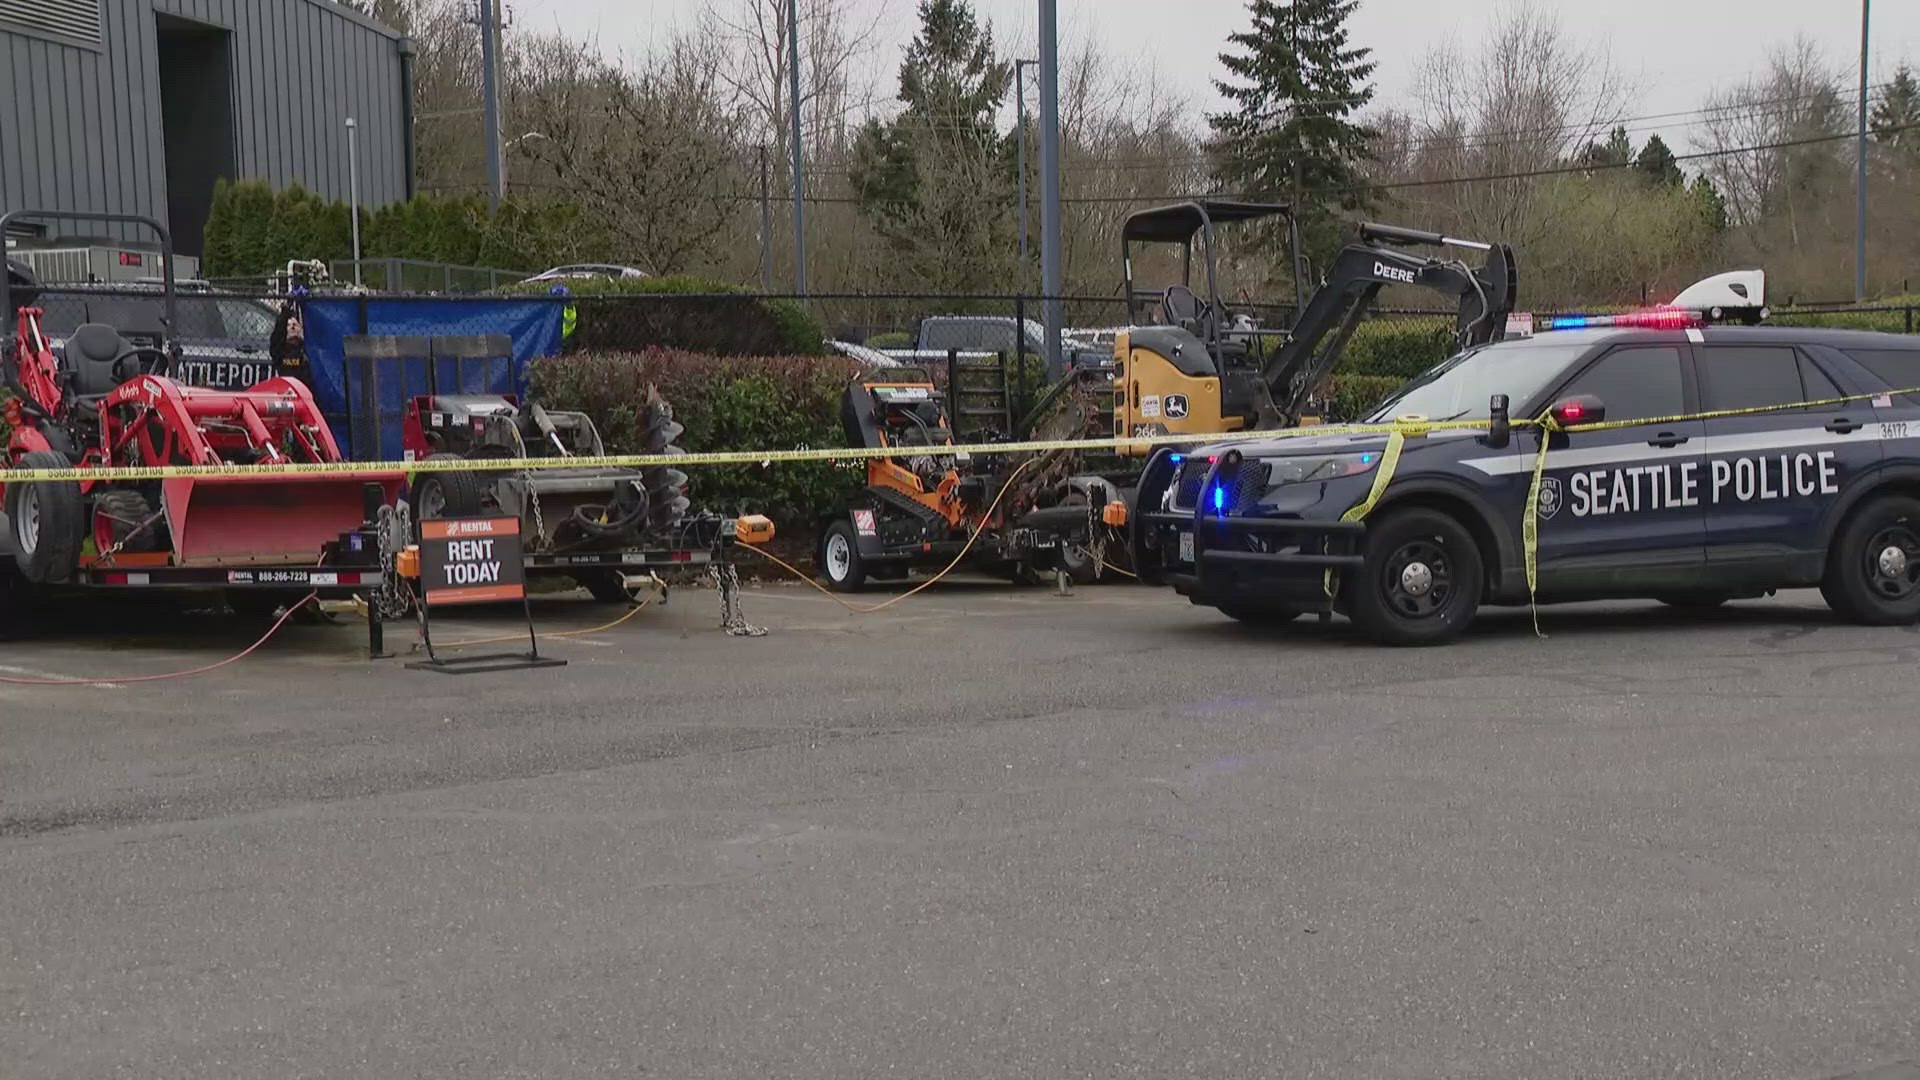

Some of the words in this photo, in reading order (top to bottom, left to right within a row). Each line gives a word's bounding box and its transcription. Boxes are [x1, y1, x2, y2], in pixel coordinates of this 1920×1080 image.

[1374, 261, 1415, 283] DEERE
[1881, 422, 1908, 438] 36172
[4, 468, 35, 479] POLICE
[48, 467, 77, 478] CROSS
[1571, 462, 1698, 517] SEATTLE
[1711, 451, 1839, 504] POLICE
[461, 521, 493, 533] RENTAL
[448, 540, 494, 561] RENT
[259, 571, 308, 581] 888-266-7228
[444, 561, 500, 585] TODAY
